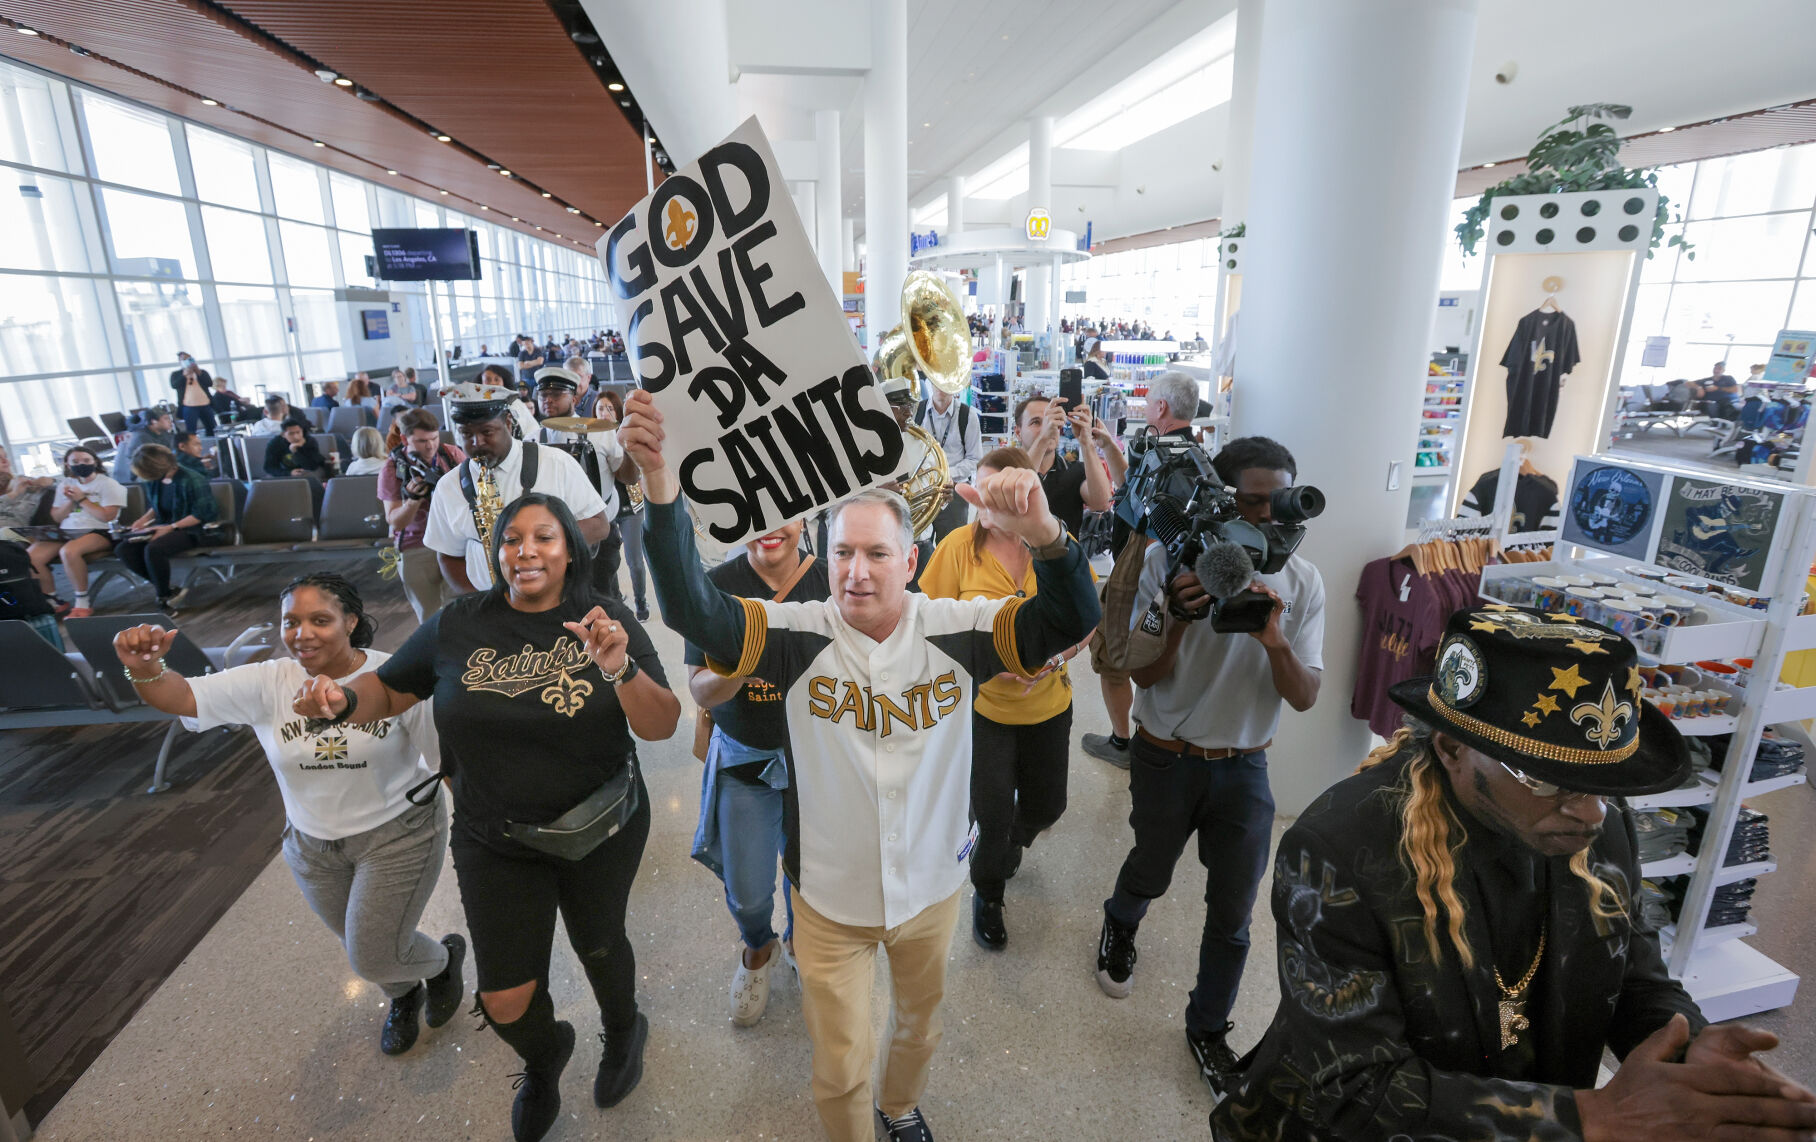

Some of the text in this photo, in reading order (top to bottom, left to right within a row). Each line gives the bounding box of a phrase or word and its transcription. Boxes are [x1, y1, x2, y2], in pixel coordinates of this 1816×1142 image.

[605, 141, 771, 300] GOD
[628, 219, 806, 394] SAVE
[687, 337, 787, 430] DA
[678, 363, 905, 544] SAINTS
[1692, 488, 1717, 499] MAY
[1720, 485, 1736, 495] BE
[461, 635, 593, 685] Saints
[808, 669, 962, 739] SAINTS
[299, 760, 368, 771] London Bound
